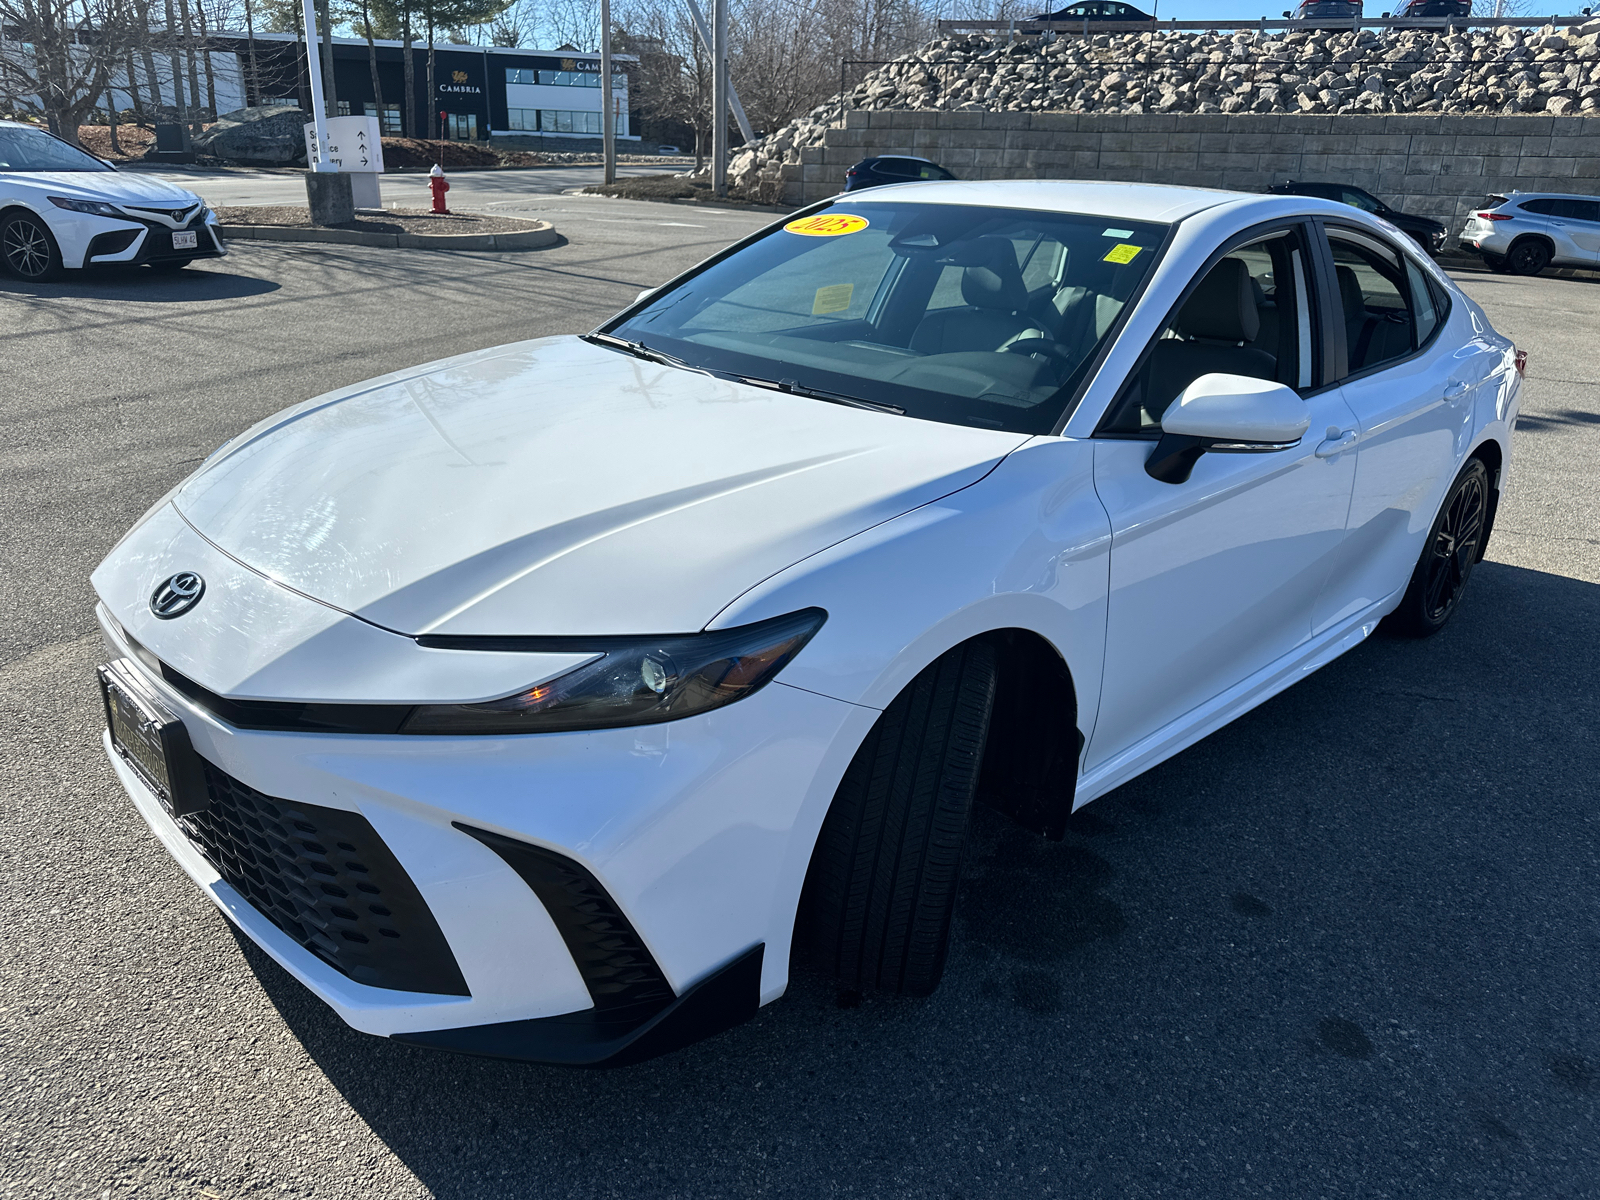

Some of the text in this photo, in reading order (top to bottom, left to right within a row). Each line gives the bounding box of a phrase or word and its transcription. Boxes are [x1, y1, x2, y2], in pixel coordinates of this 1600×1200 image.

[577, 61, 621, 72] CAMIA
[439, 83, 481, 94] CAMBRIA
[790, 217, 860, 232] 2025
